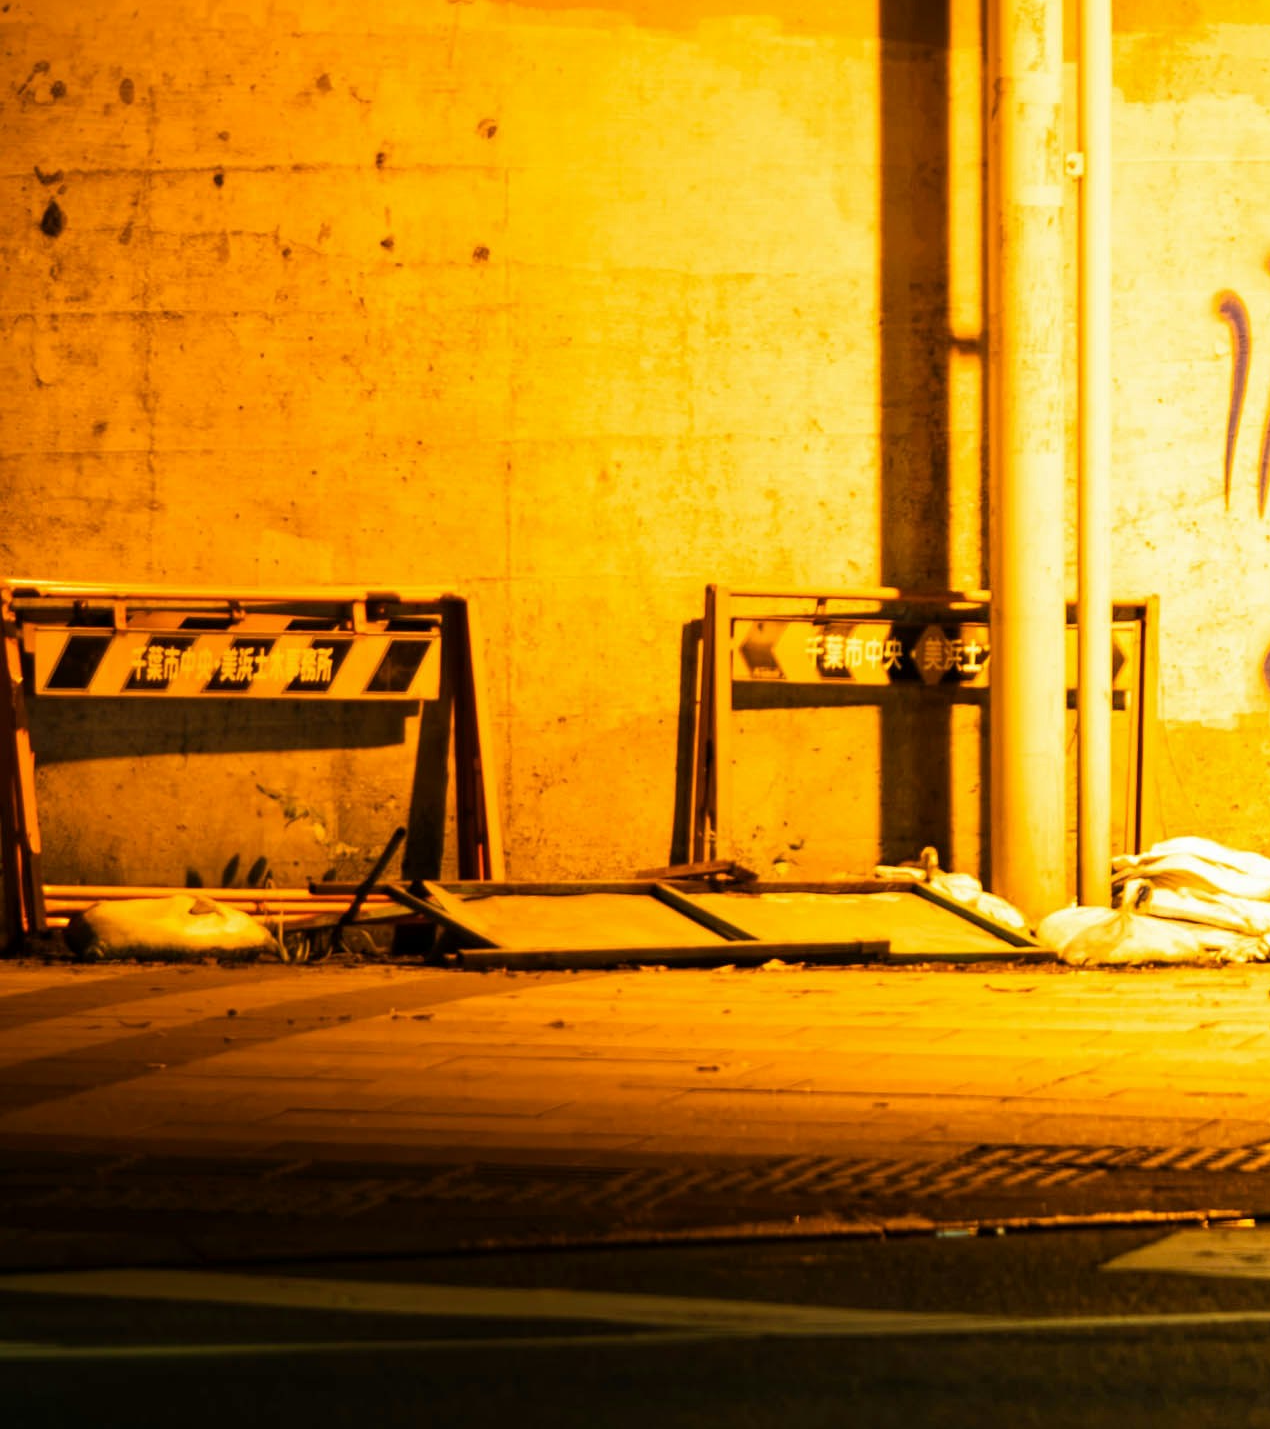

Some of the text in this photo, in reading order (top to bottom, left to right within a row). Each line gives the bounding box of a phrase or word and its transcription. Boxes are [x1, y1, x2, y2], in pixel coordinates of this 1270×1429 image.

[804, 634, 990, 673] 千葉市中央・美浜土
